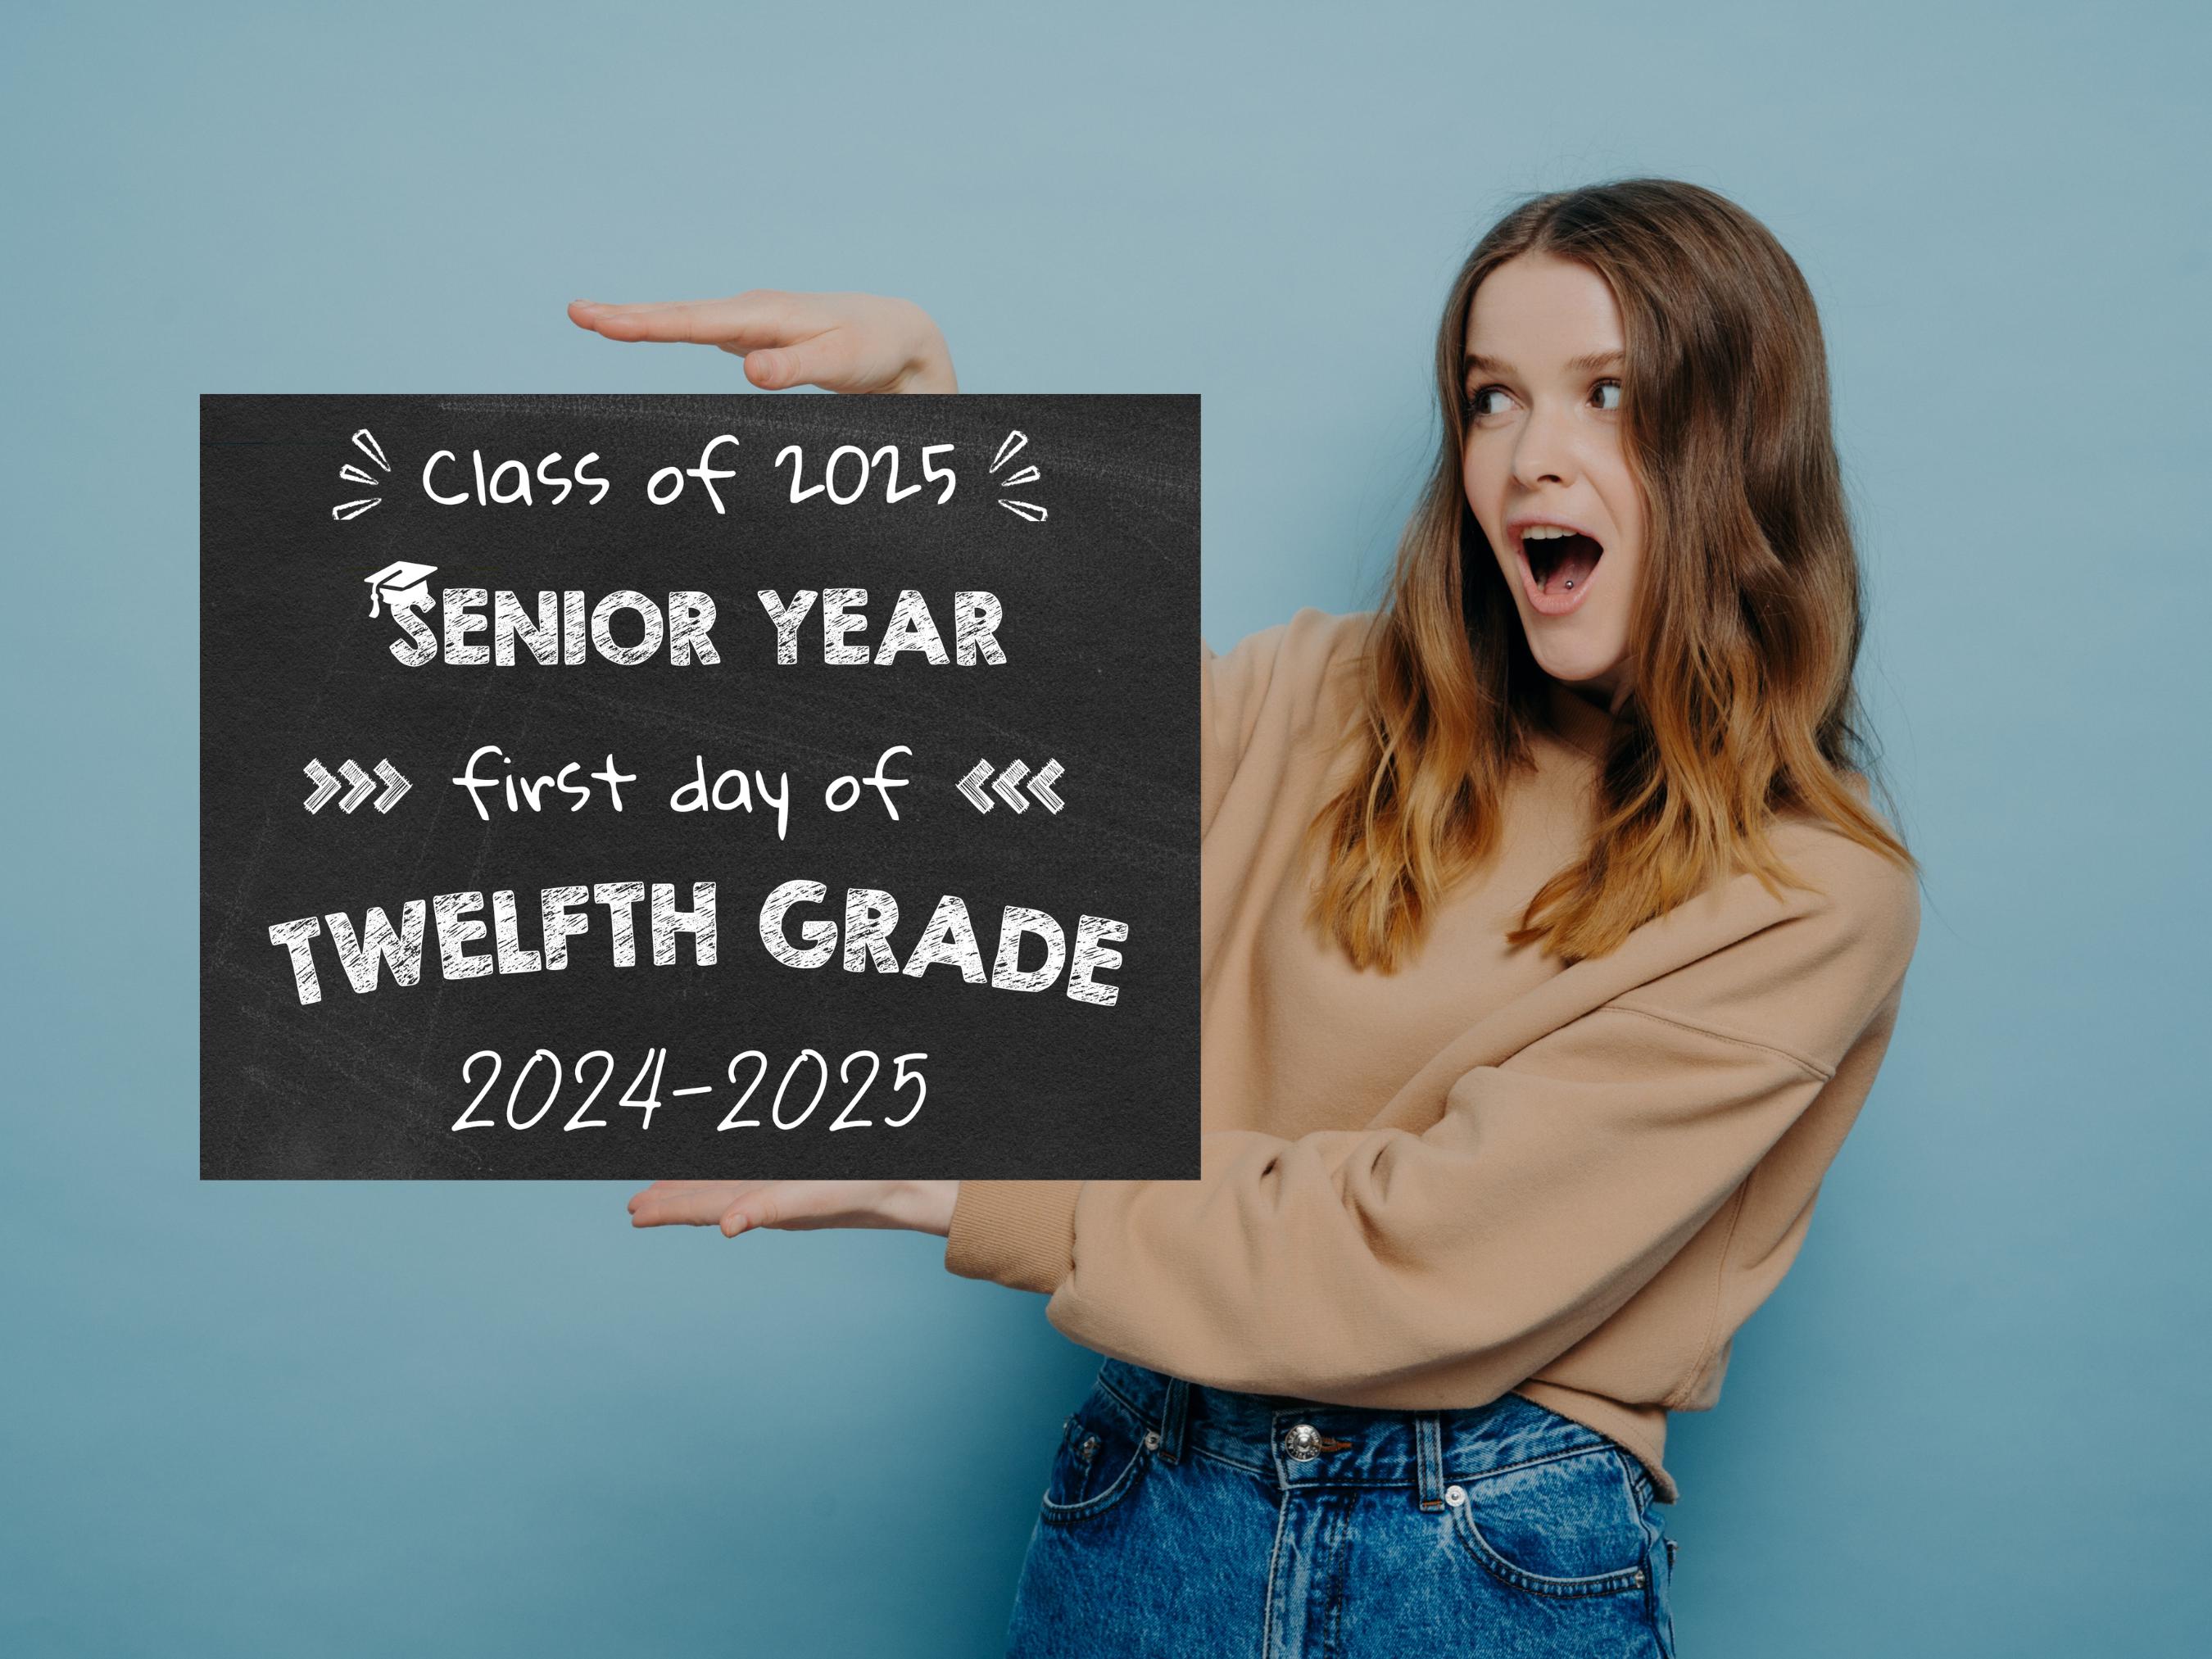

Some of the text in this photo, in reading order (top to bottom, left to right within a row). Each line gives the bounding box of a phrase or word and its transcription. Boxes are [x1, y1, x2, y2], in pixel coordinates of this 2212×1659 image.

[423, 435, 955, 514] Class of 2025
[389, 587, 1007, 667] SENIOR YEAR
[452, 746, 912, 841] first day of
[269, 880, 1128, 1006] TWELFTH GRADE
[451, 1048, 927, 1131] 2024-2025
